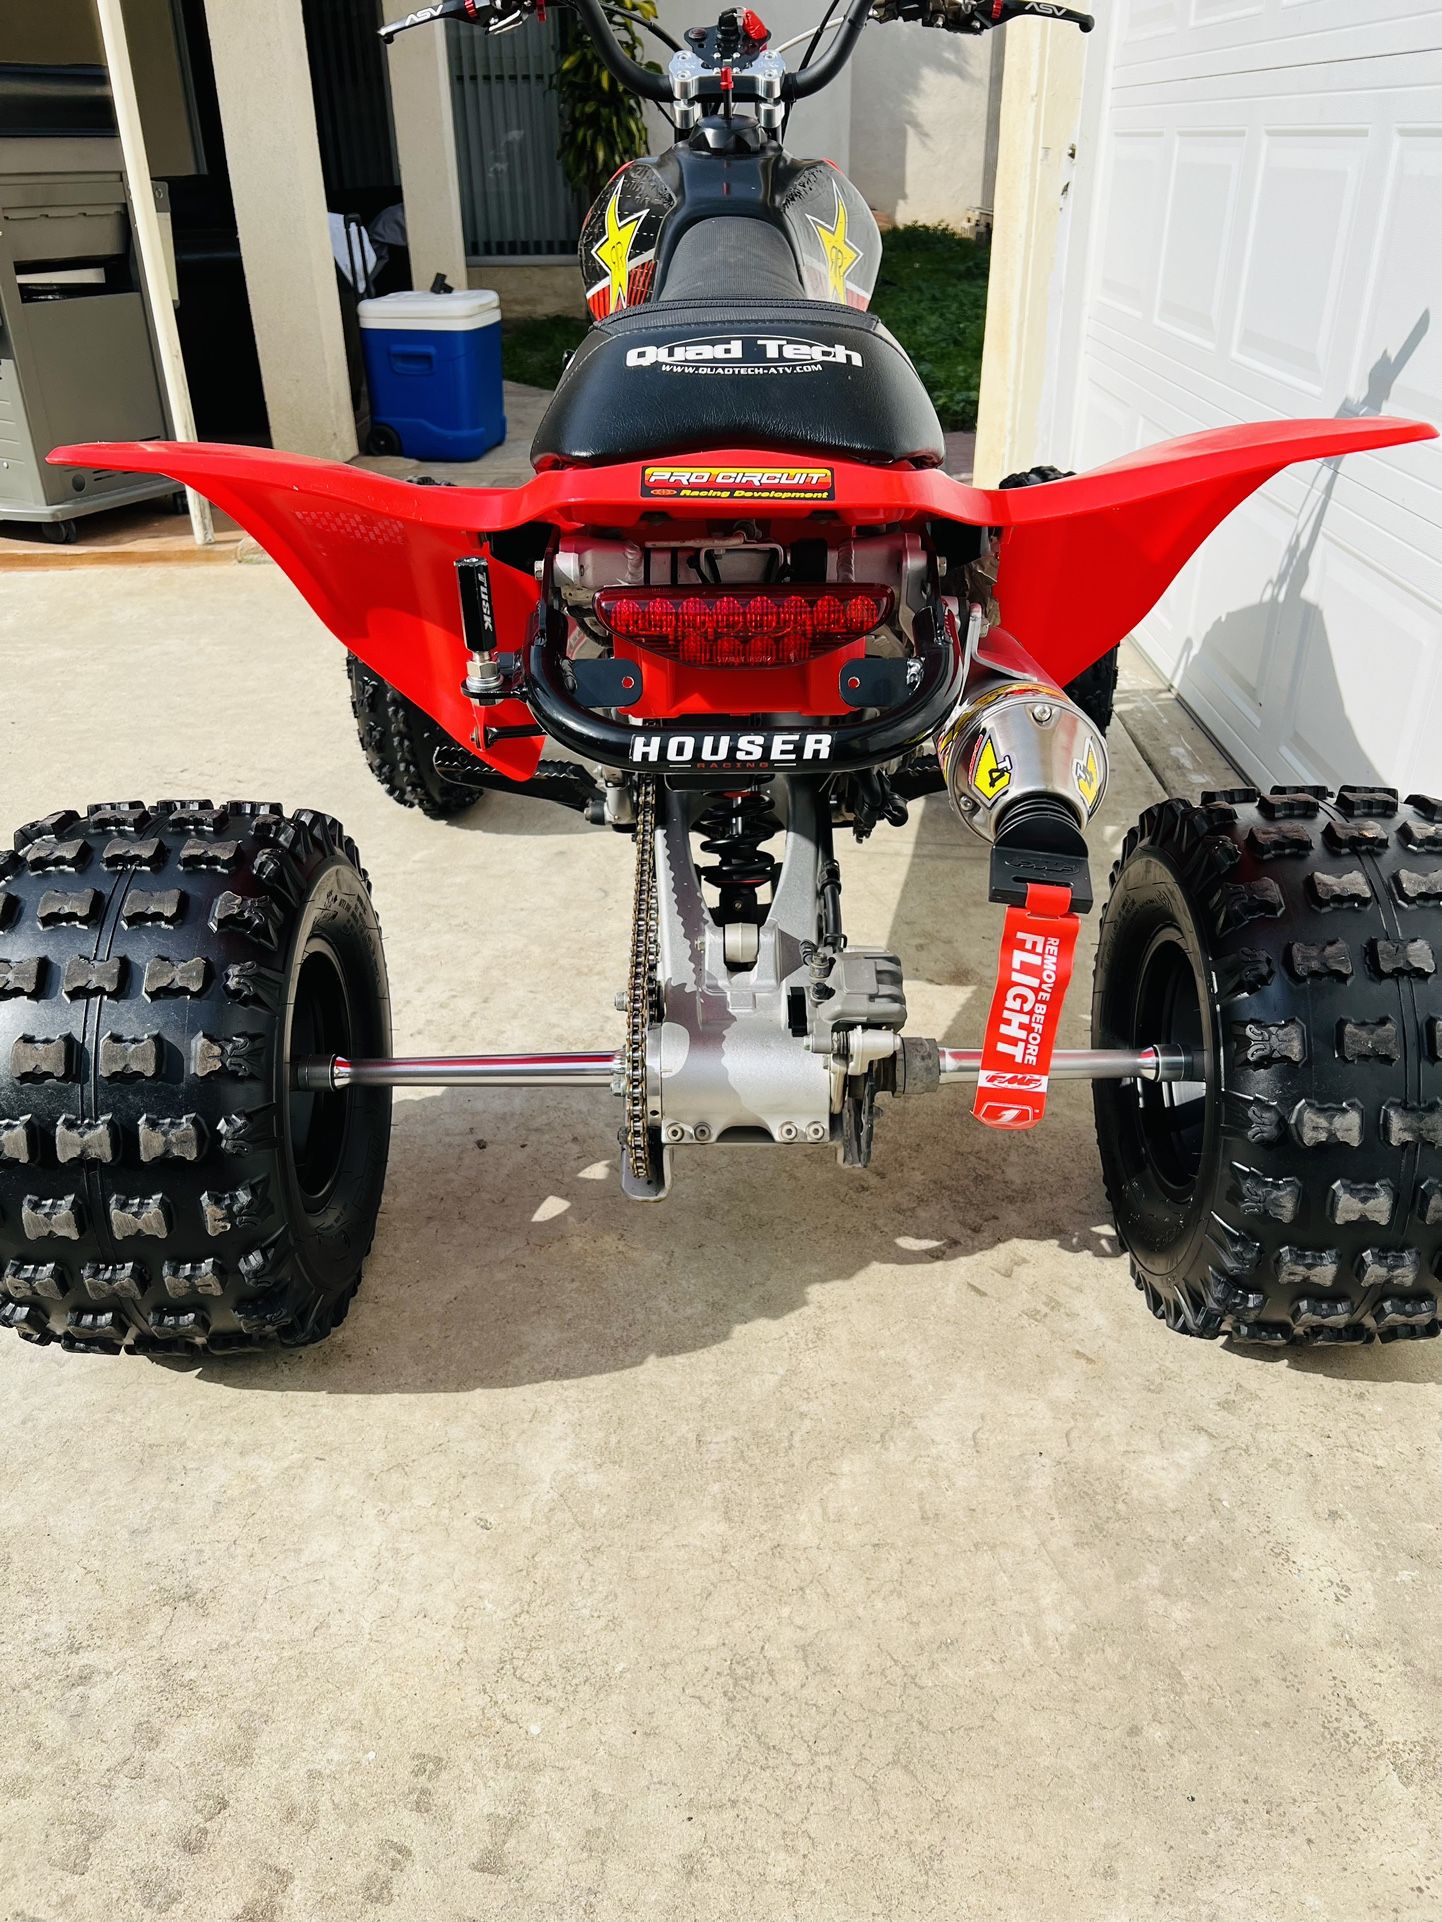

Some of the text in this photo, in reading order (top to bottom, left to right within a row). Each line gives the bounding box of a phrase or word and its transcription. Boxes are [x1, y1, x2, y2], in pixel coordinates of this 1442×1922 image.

[405, 4, 443, 26] ASV
[1024, 2, 1067, 16] ASV
[626, 340, 863, 367] Quad Tech
[661, 364, 822, 375] WWW.QUADTECH-ATV.COM
[649, 471, 827, 487] PRO CIRCUIT
[679, 489, 829, 499] Racing Development
[478, 572, 493, 632] TUSK
[632, 734, 832, 762] HOUSER
[996, 931, 1045, 1064] FLIGHT
[1024, 937, 1060, 1066] REMOVE BEFORE
[986, 1074, 1042, 1086] FMF
